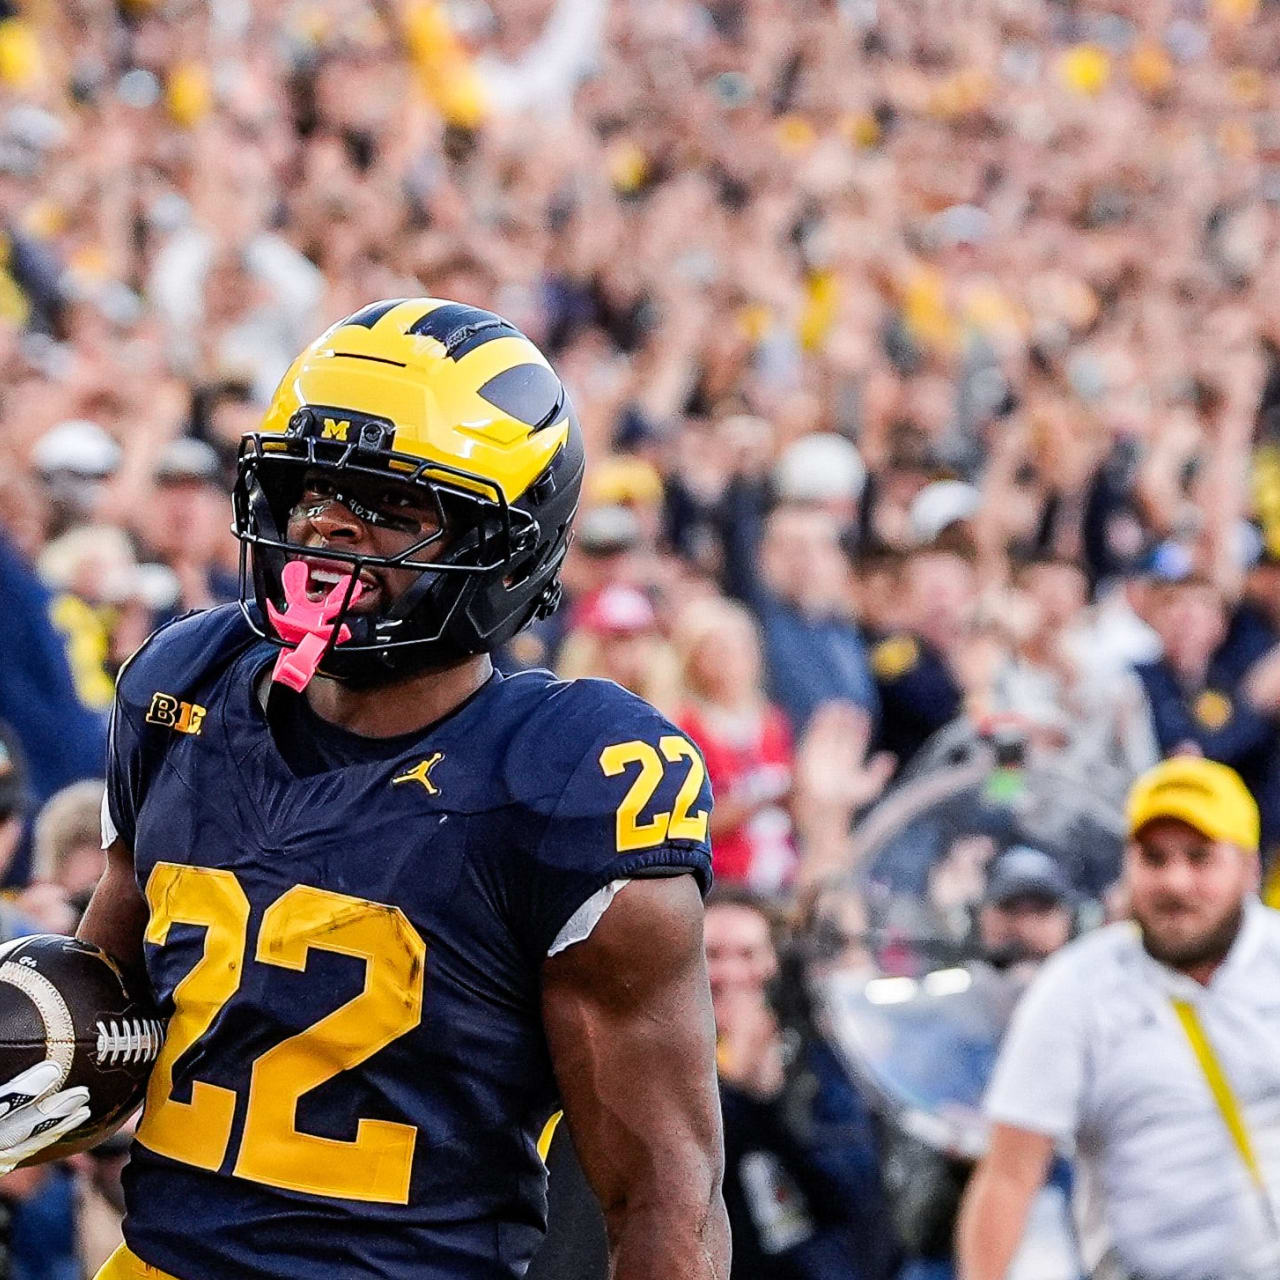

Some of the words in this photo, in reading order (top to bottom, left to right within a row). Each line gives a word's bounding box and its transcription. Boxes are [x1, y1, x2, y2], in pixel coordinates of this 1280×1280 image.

[320, 417, 351, 442] M
[599, 735, 709, 853] 22
[134, 861, 427, 1206] 22
